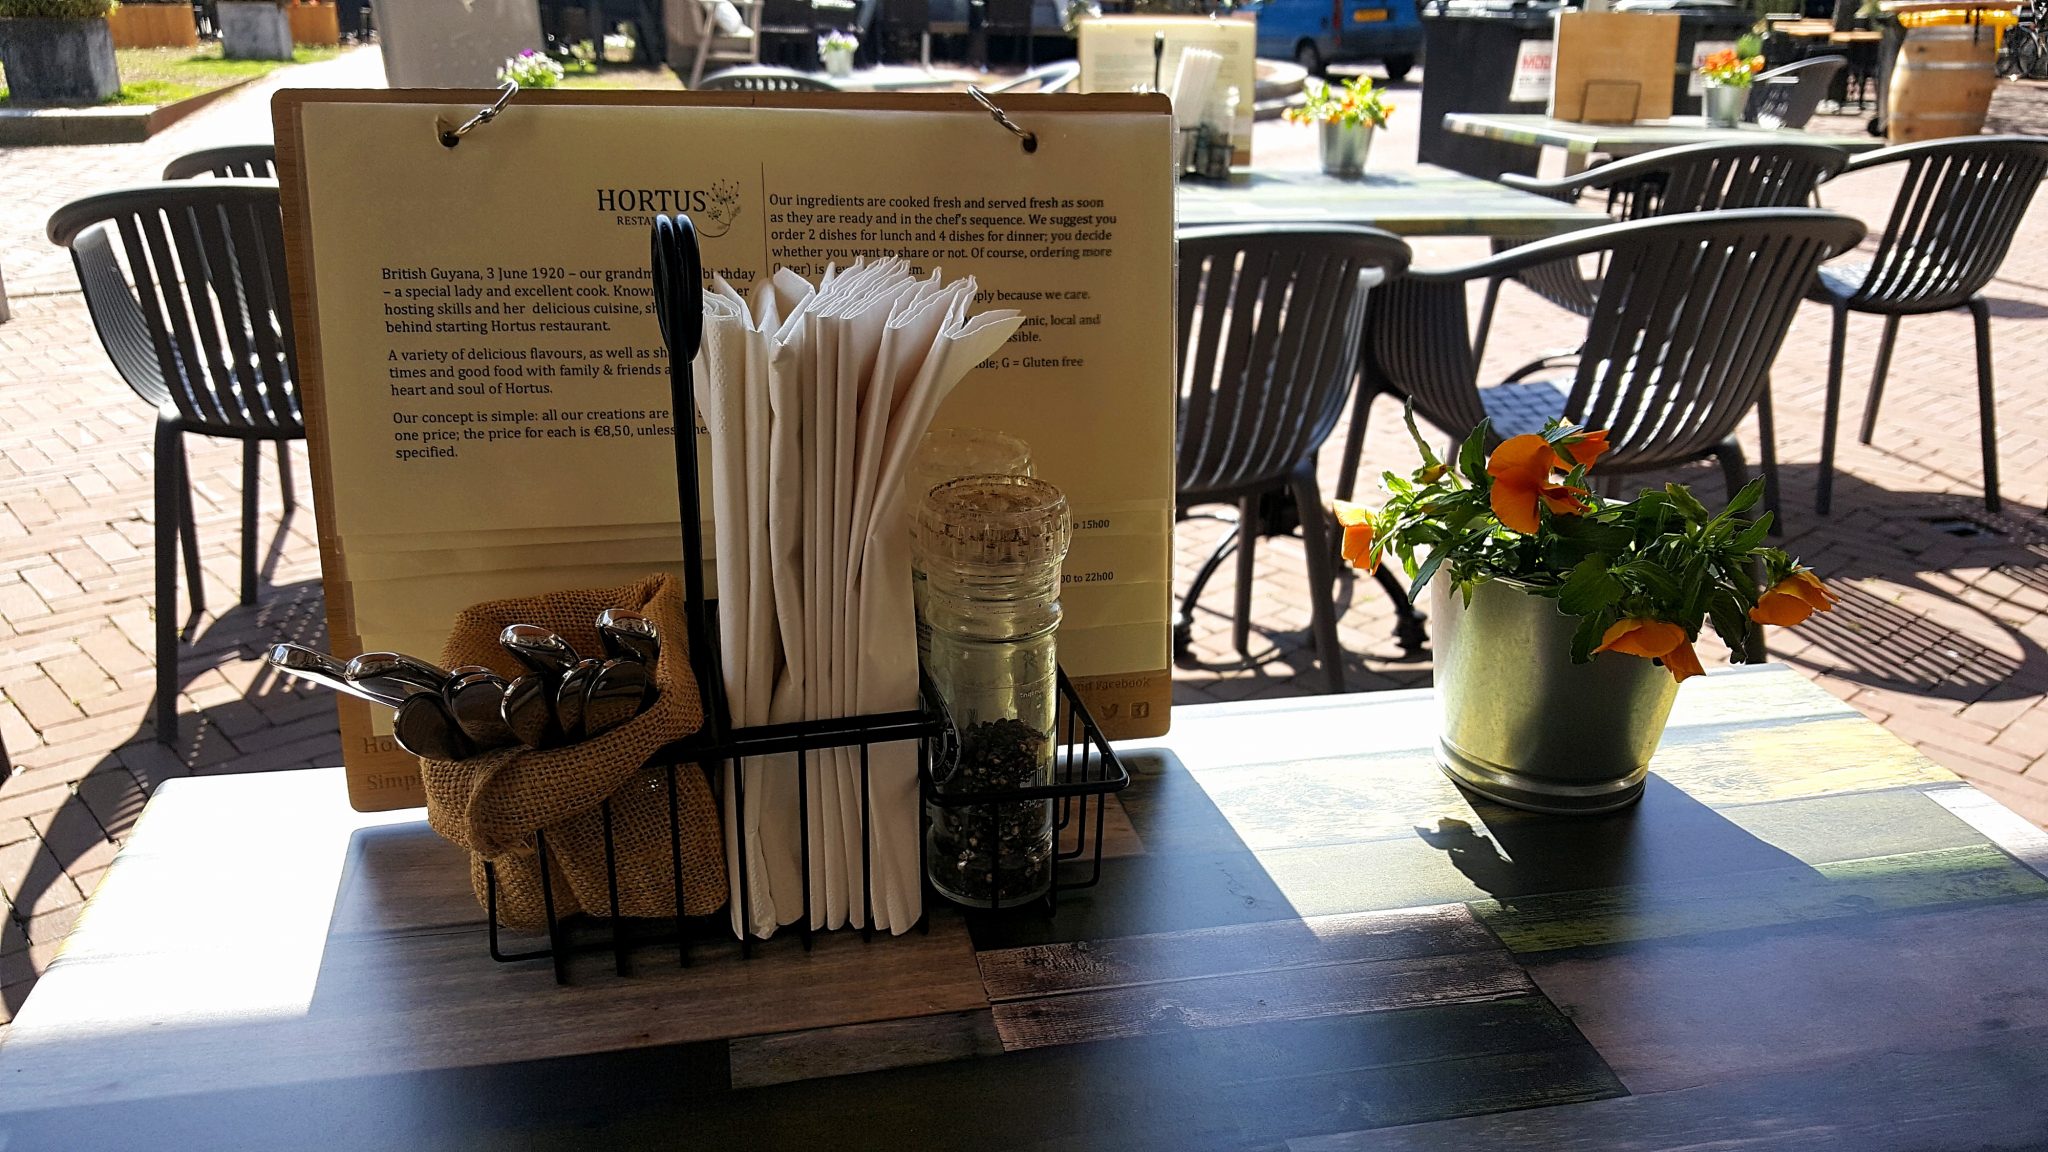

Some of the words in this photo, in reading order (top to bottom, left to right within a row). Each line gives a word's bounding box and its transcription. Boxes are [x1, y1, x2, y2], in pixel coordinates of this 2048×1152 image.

[597, 189, 706, 212] HORTUS
[770, 194, 792, 205] Our
[796, 194, 864, 208] ingredients
[867, 198, 886, 207] are
[889, 196, 930, 208] cooked
[934, 196, 961, 208] fresh
[964, 197, 984, 208] and
[988, 197, 1026, 208] served
[1030, 197, 1058, 208] fresh
[1061, 200, 1074, 208] as
[1076, 200, 1104, 208] soon
[770, 214, 783, 222] as
[787, 211, 813, 226] they
[817, 215, 835, 223] are
[840, 212, 873, 227] ready
[876, 213, 896, 224] and
[901, 214, 911, 224] in
[915, 213, 932, 224] the
[936, 214, 966, 225] chef's
[970, 217, 1025, 228] sequence.
[1028, 214, 1047, 224] We
[1050, 215, 1092, 227] suggest
[1096, 216, 1116, 227] you
[771, 228, 805, 240] order
[809, 229, 815, 240] 2
[819, 229, 856, 240] dishes
[861, 229, 877, 240] for
[880, 229, 912, 241] lunch
[915, 230, 936, 241] and
[939, 231, 946, 241] 4
[949, 230, 984, 241] dishes
[987, 230, 1004, 241] for
[1007, 230, 1048, 242] dinner;
[1051, 233, 1072, 244] you
[1075, 230, 1112, 240] decide
[772, 246, 823, 257] whether
[826, 249, 848, 260] you
[851, 248, 880, 258] want
[884, 247, 894, 258] to
[897, 246, 929, 258] share
[932, 250, 945, 258] or
[948, 249, 968, 258] not.
[971, 247, 984, 258] Of
[987, 250, 1027, 258] course,
[1030, 247, 1080, 260] ordering
[382, 268, 427, 279] British
[431, 268, 483, 282] Guyana,
[487, 268, 494, 279] 3
[498, 268, 527, 281] June
[532, 267, 564, 279] 1920
[580, 270, 602, 279] our
[703, 267, 755, 281] bithday
[773, 263, 810, 276] (lter)
[815, 264, 825, 274] is
[395, 289, 402, 297] a
[406, 285, 450, 300] special
[454, 285, 482, 299] lady
[486, 284, 511, 296] and
[515, 284, 573, 296] excellent
[576, 284, 609, 296] cook.
[997, 290, 1042, 300] because
[1045, 292, 1062, 300] we
[384, 303, 434, 318] hosting
[438, 302, 472, 314] skills
[475, 302, 499, 314] and
[503, 302, 525, 314] her
[532, 302, 590, 314] delicious
[594, 302, 642, 315] cuisine,
[1050, 314, 1076, 325] local
[1080, 314, 1101, 325] and
[385, 320, 432, 332] behind
[436, 321, 488, 335] starting
[491, 320, 536, 332] Hortus
[540, 321, 610, 331] restaurant.
[388, 350, 398, 360] A
[401, 350, 448, 363] variety
[452, 348, 465, 360] of
[468, 348, 526, 360] delicious
[530, 348, 586, 360] flavours,
[590, 350, 602, 358] as
[606, 347, 633, 358] well
[637, 350, 649, 358] as
[1002, 358, 1009, 368] G
[1023, 357, 1059, 367] Gluten
[1062, 356, 1083, 366] free
[390, 367, 426, 378] times
[430, 366, 454, 377] and
[458, 365, 490, 380] good
[494, 365, 523, 376] food
[526, 364, 555, 376] with
[560, 364, 600, 378] family
[603, 364, 613, 375] &
[617, 364, 661, 375] friends
[390, 384, 427, 396] heart
[430, 383, 454, 395] and
[458, 383, 485, 394] soul
[489, 383, 503, 394] of
[505, 383, 552, 394] Hortus.
[394, 412, 418, 423] Our
[422, 412, 474, 425] concept
[477, 411, 487, 422] is
[492, 410, 538, 424] simple:
[542, 409, 557, 420] all
[561, 412, 583, 420] our
[587, 409, 645, 420] creations
[649, 410, 669, 418] are
[395, 432, 418, 441] one
[423, 429, 459, 443] price;
[464, 428, 484, 439] the
[488, 428, 521, 442] price
[525, 427, 543, 438] for
[547, 426, 576, 438] each
[580, 426, 590, 437] is
[594, 425, 633, 438] €8,50,
[637, 424, 677, 436] unless
[396, 446, 458, 461] specified.
[1082, 520, 1110, 529] 15h00
[1085, 572, 1114, 582] 22h00
[1096, 677, 1151, 690] Facebook
[362, 737, 401, 754] Hor
[367, 774, 421, 791] Simp
